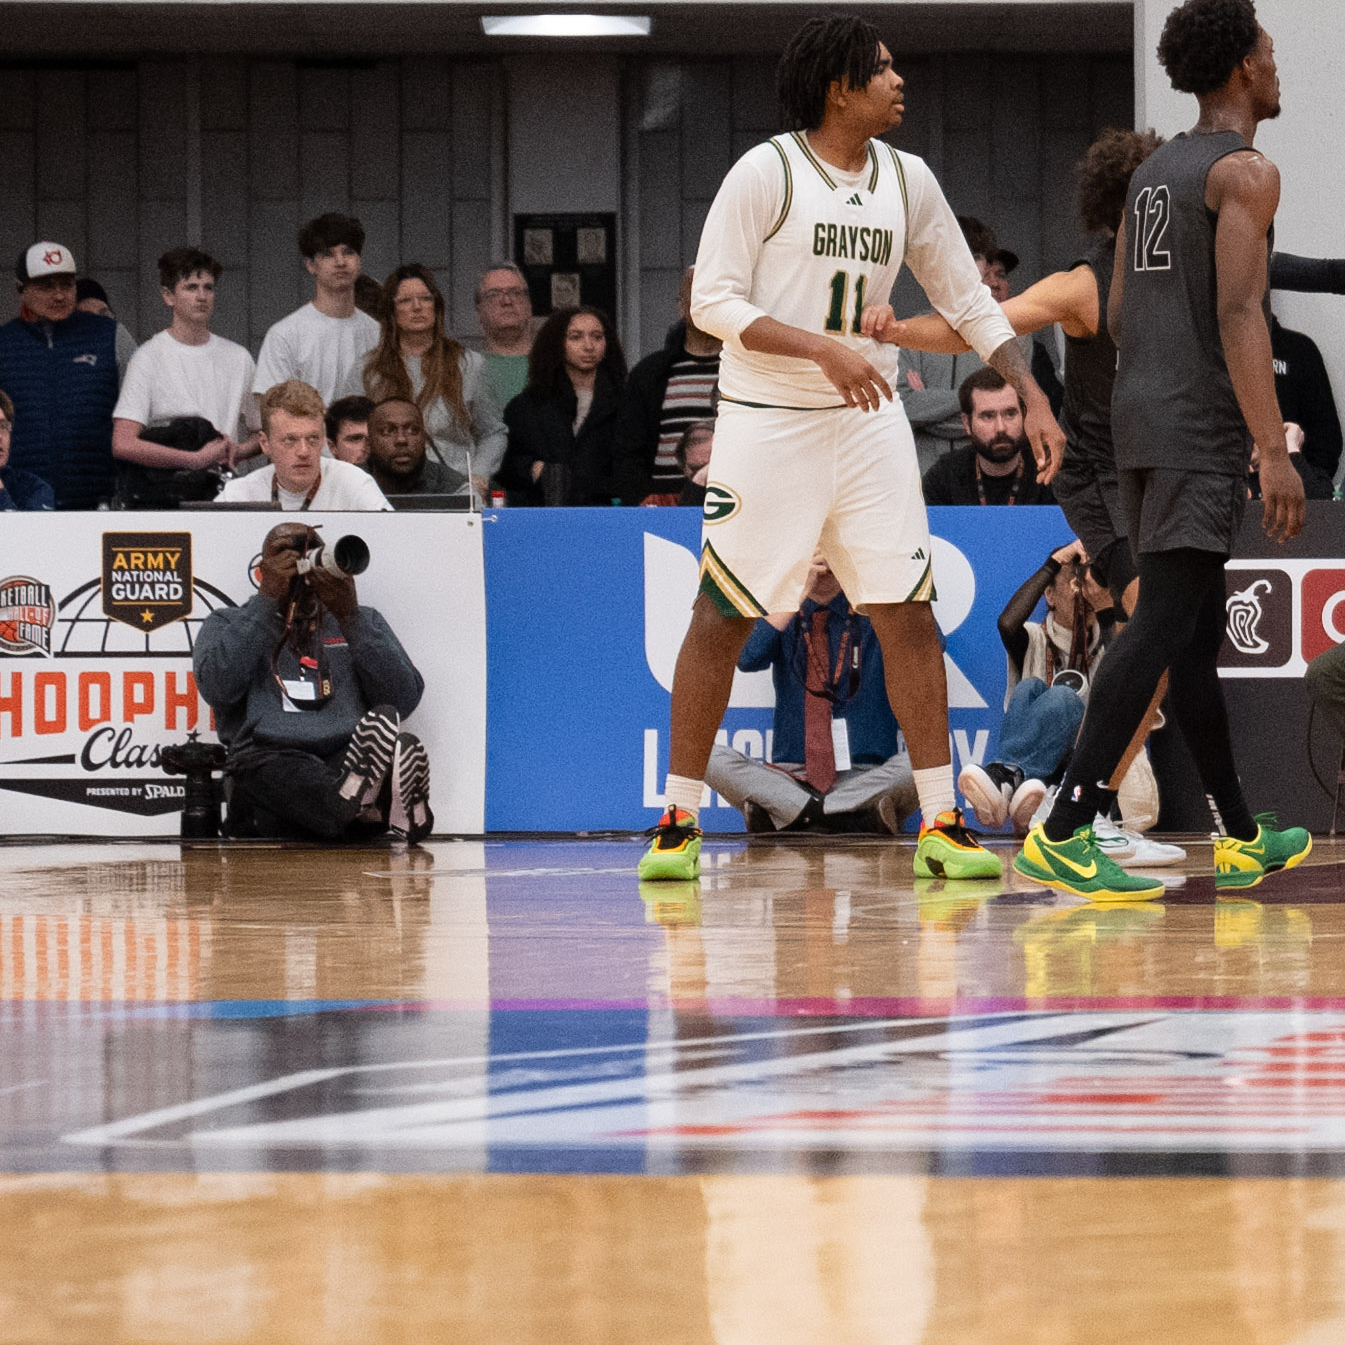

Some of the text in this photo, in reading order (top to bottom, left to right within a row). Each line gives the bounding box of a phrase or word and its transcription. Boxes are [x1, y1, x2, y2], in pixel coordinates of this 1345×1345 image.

[1133, 183, 1171, 271] 12
[812, 222, 894, 266] GRAYSON
[823, 269, 869, 337] 11
[111, 570, 183, 583] NATIONAL
[112, 552, 182, 570] ARMY
[0, 585, 48, 607] KETBALL
[111, 583, 184, 601] GUARD
[0, 671, 200, 739] HOOPH
[80, 726, 164, 773] Clas
[86, 784, 186, 801] PRESENTED BY SPALD
